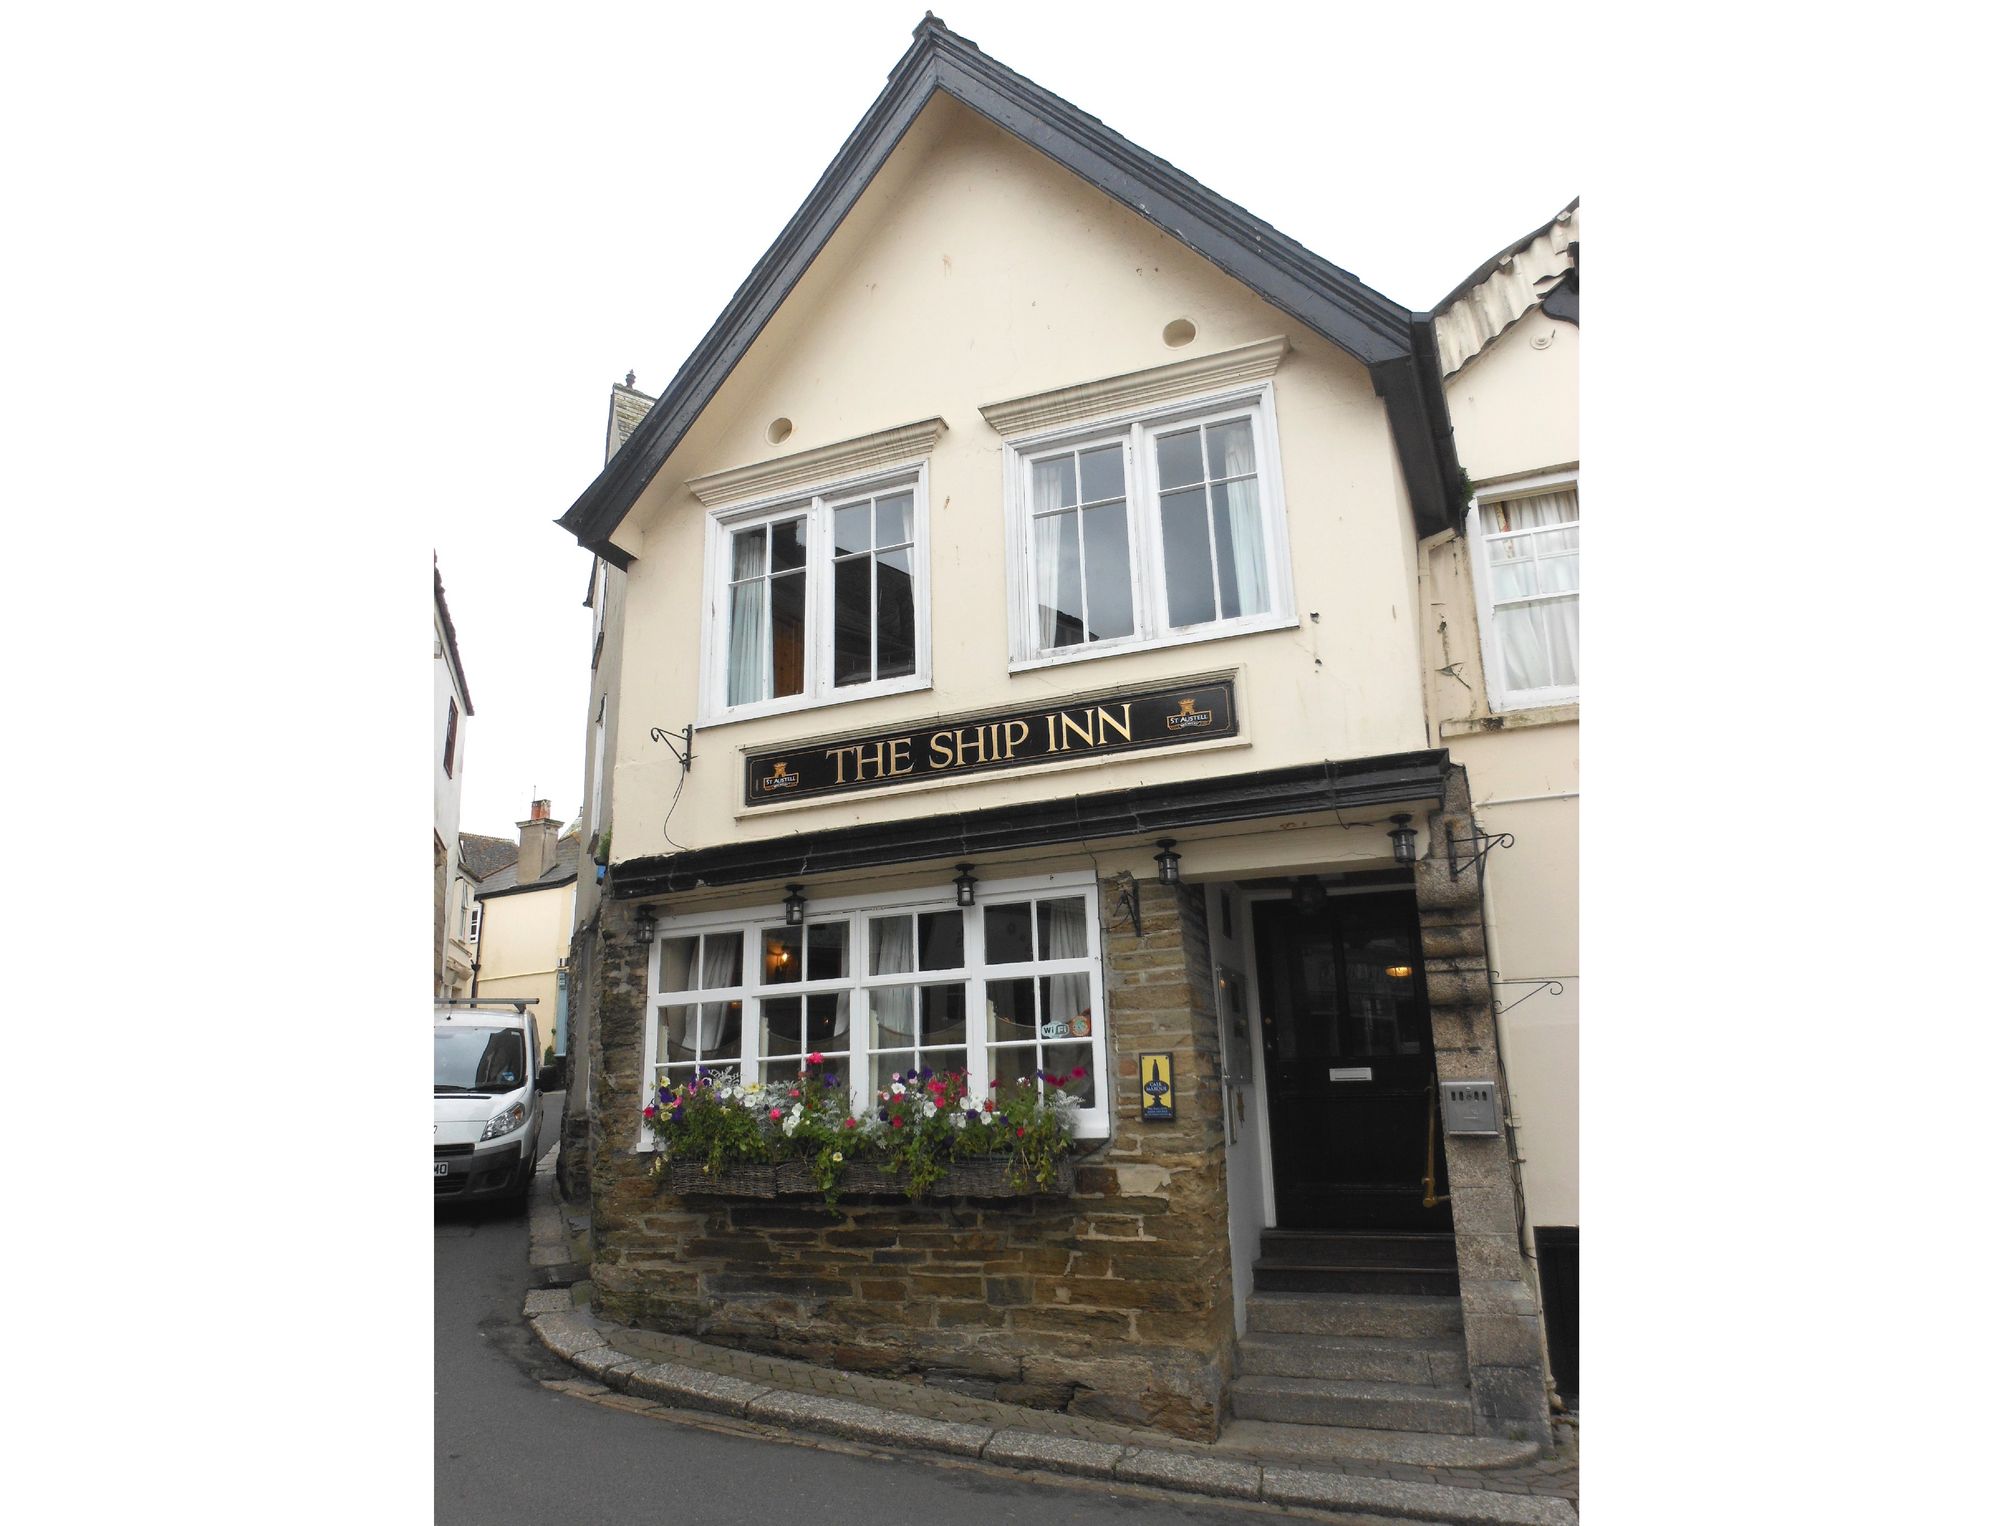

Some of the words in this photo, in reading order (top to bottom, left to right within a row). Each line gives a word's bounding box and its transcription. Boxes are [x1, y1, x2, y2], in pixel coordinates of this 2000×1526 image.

[1180, 714, 1207, 722] AUSTELL
[826, 738, 912, 784] THE
[929, 720, 1029, 769] SHIP
[1045, 704, 1132, 752] INN
